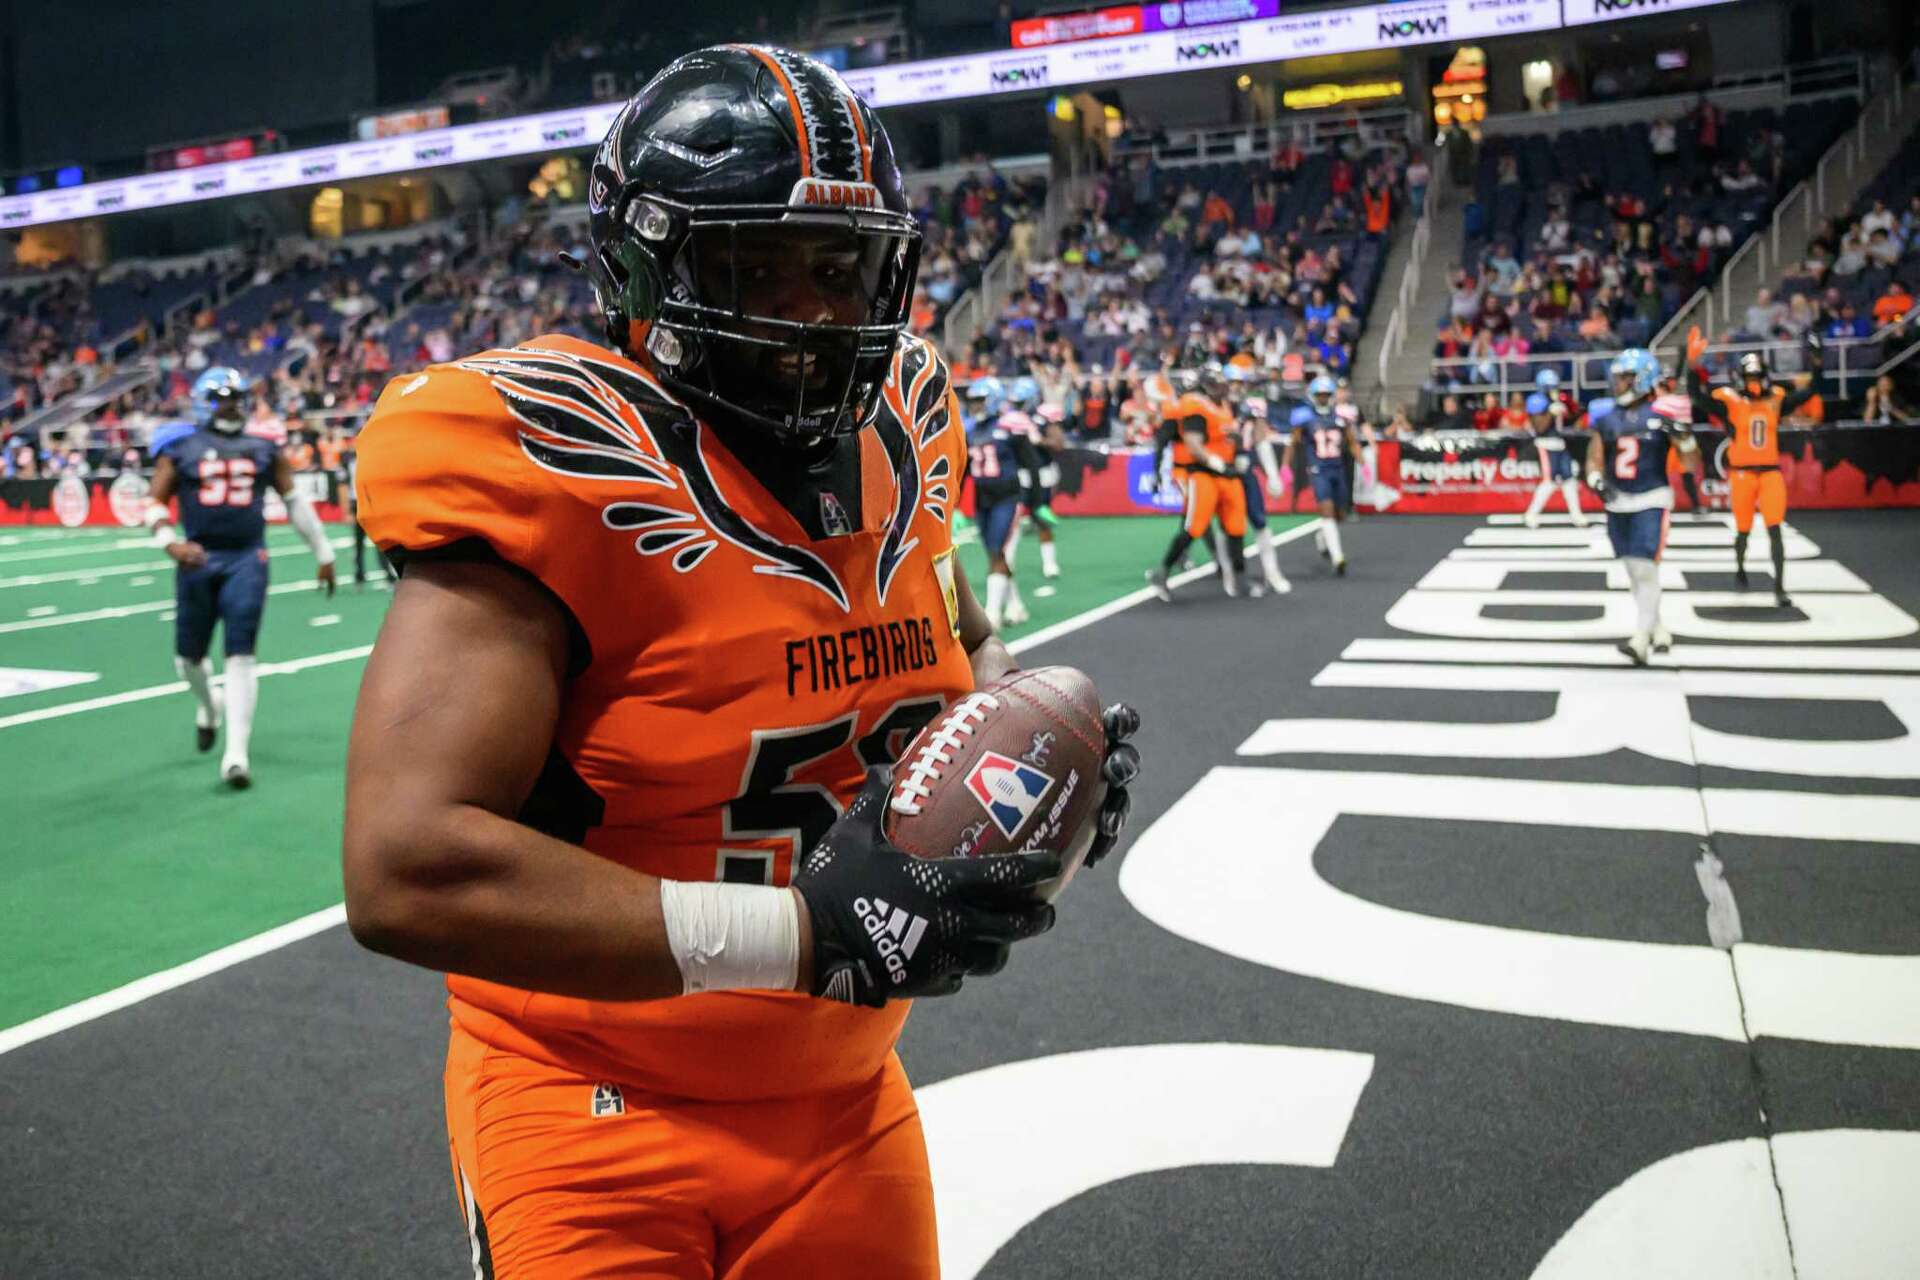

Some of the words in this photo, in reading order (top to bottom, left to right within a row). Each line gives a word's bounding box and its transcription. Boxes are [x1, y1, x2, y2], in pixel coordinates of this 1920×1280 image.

[1378, 16, 1448, 40] NOW!
[1177, 38, 1240, 62] NOW!
[805, 184, 876, 208] ALBANY
[1749, 414, 1768, 450] 0
[1400, 459, 1498, 487] Property
[1615, 434, 1640, 480] 2
[785, 617, 938, 697] FIREBIRDS
[1048, 768, 1079, 825] ISSUE
[853, 897, 907, 985] adidas
